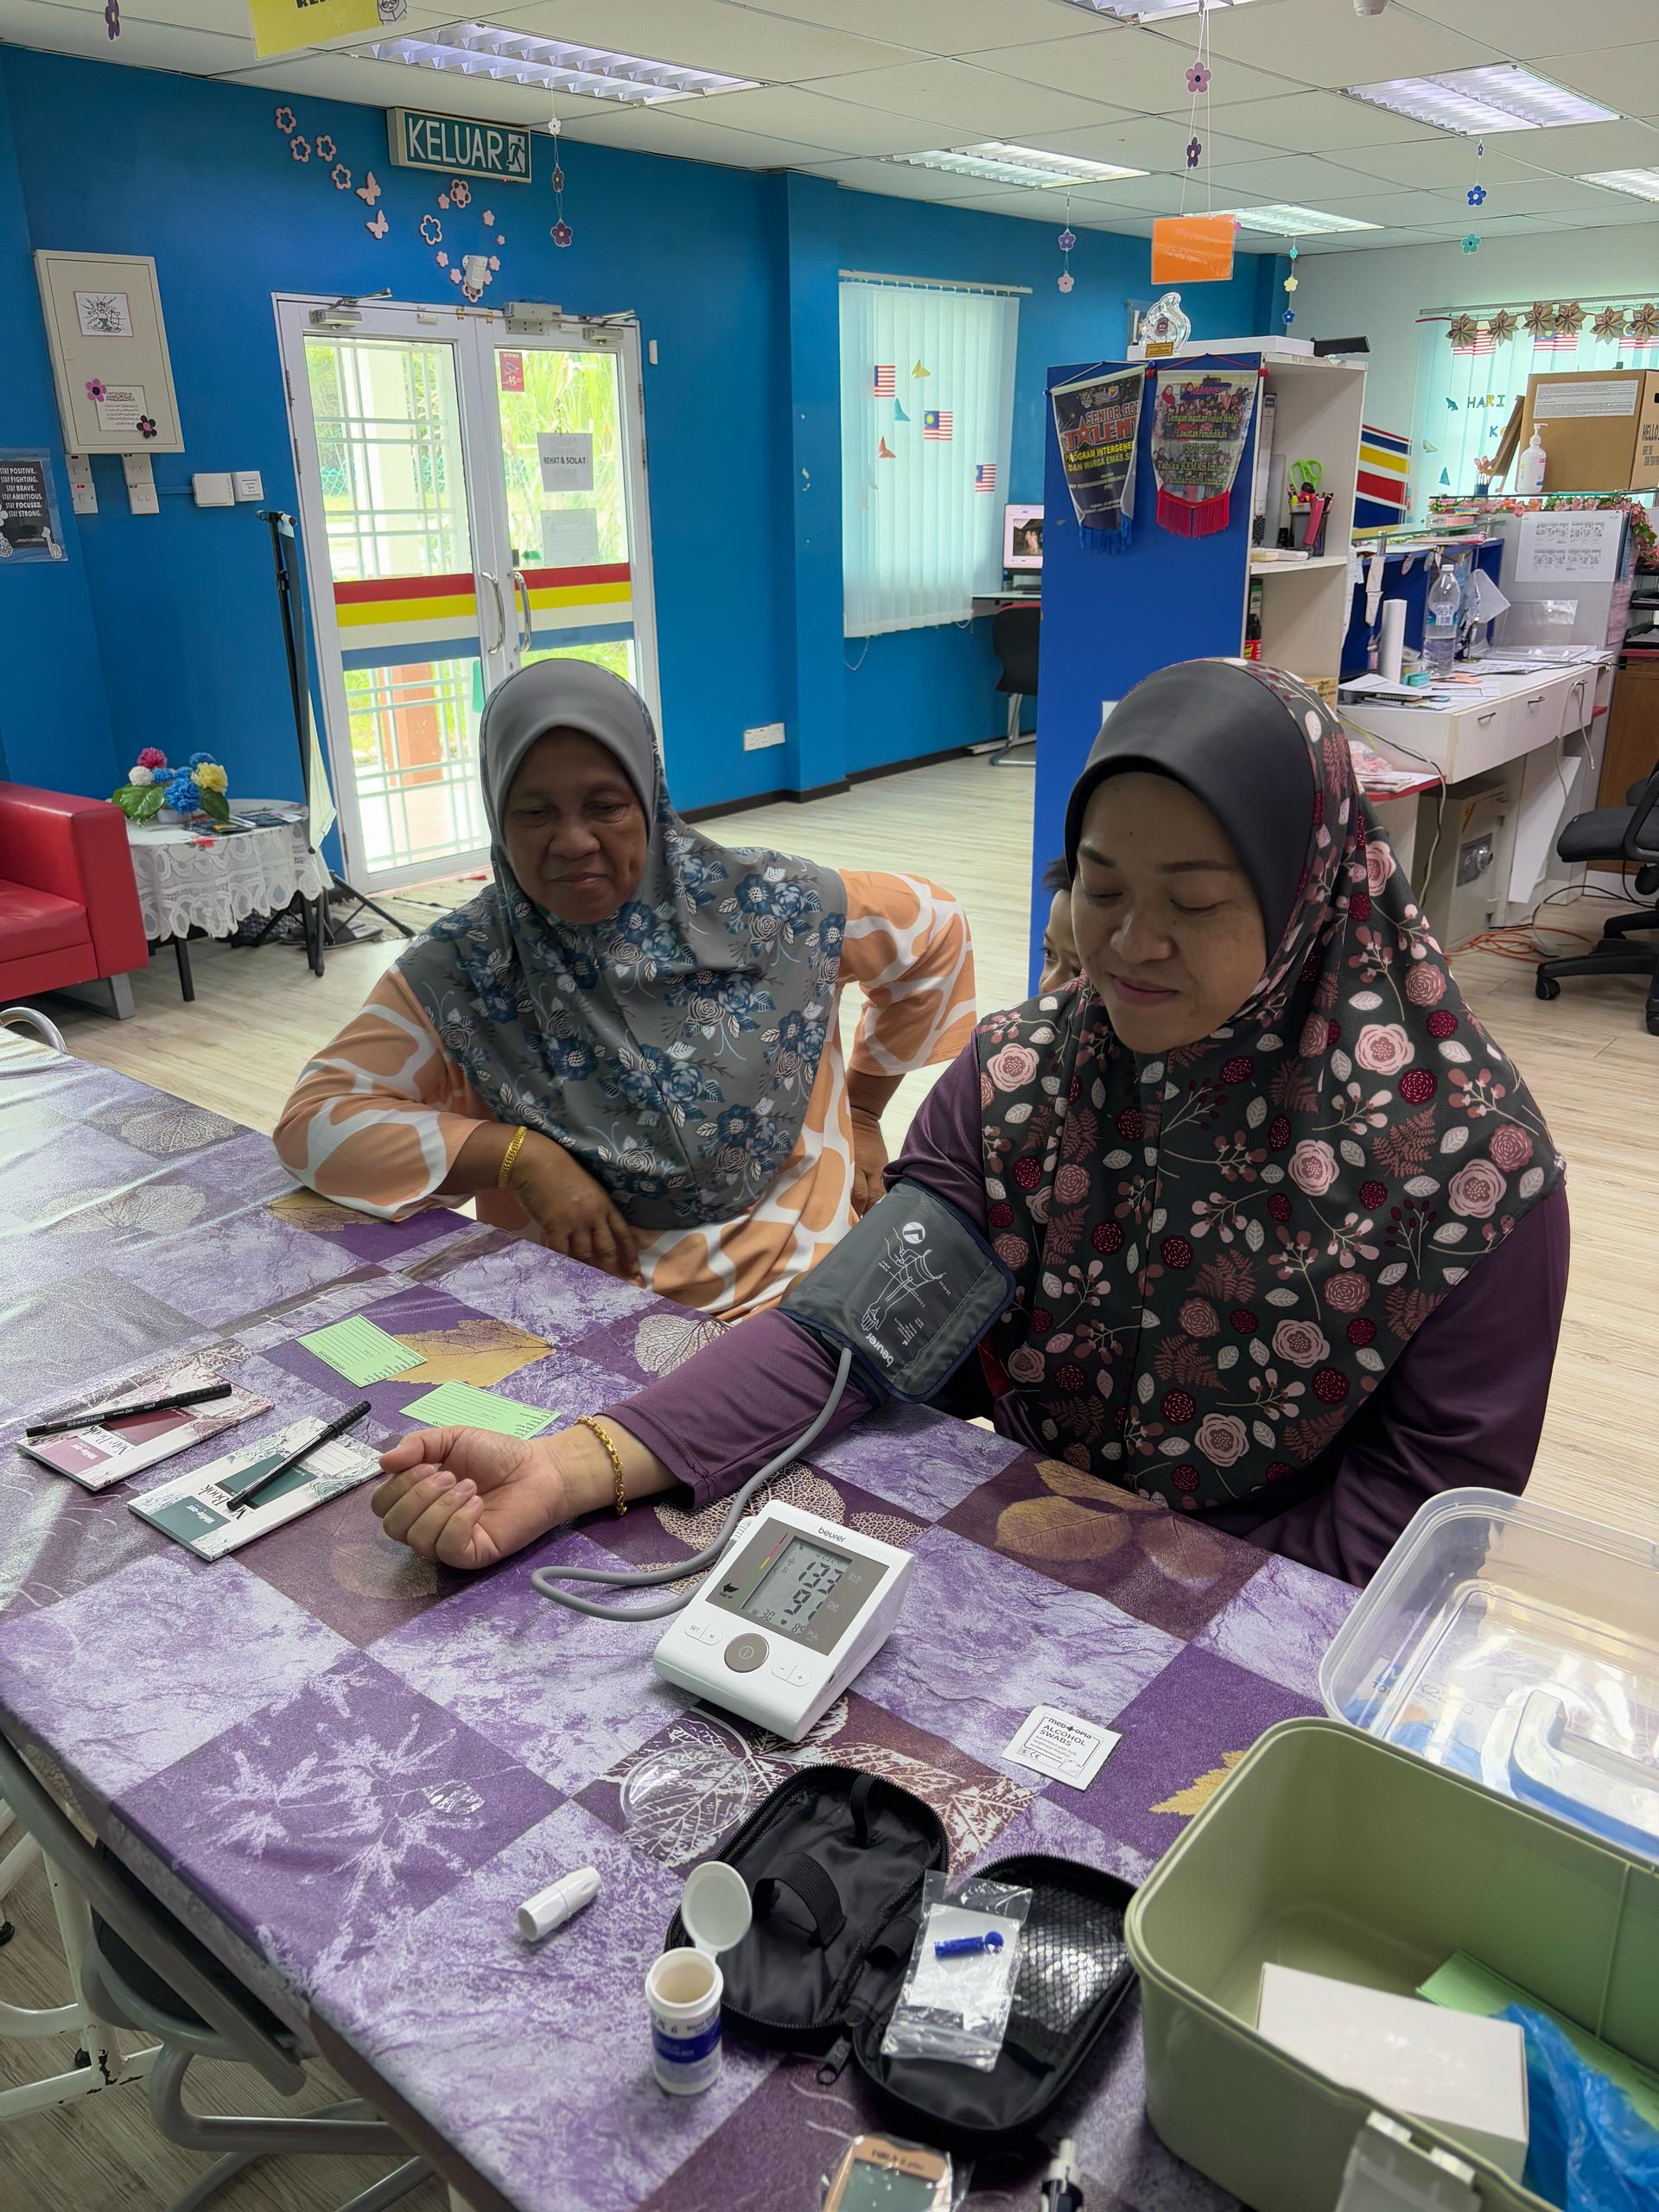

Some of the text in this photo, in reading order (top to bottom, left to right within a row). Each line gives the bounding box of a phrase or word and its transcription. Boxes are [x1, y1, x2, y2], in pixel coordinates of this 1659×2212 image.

[408, 118, 503, 170] KELUAR
[1467, 394, 1505, 409] HARI
[1085, 405, 1121, 425] SENIOR
[865, 1332, 894, 1368] beurer
[197, 1484, 231, 1507] Book
[817, 1527, 848, 1543] beurer
[798, 1561, 844, 1595] 133
[1039, 1729, 1072, 1746] SWABS
[1043, 1725, 1086, 1746] ALCOHOL
